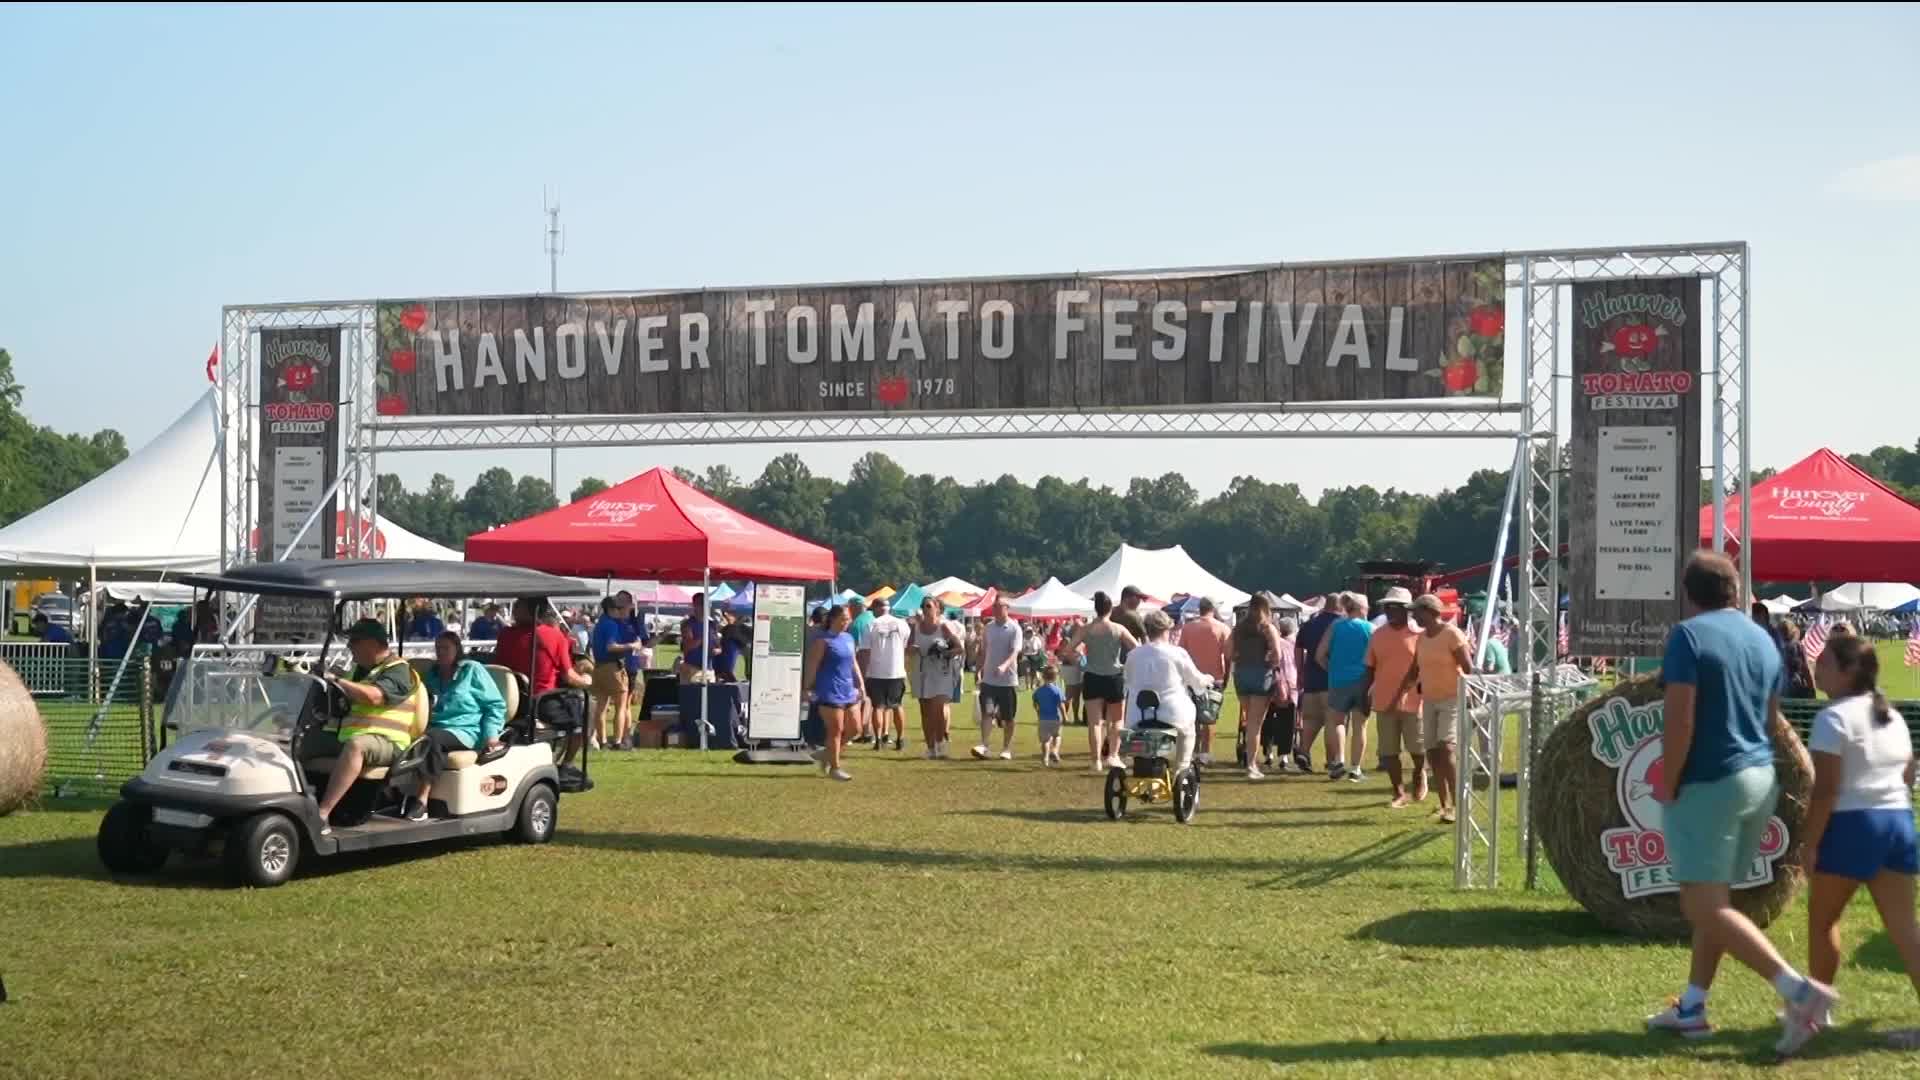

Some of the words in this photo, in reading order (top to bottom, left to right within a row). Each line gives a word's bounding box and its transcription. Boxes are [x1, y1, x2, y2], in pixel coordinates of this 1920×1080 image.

[1582, 290, 1686, 328] Hanover
[433, 312, 711, 392] HANOVER
[745, 299, 1015, 365] TOMATO
[1055, 290, 1419, 372] FESTIVAL
[819, 381, 865, 397] SINCE
[916, 378, 954, 395] 1978
[1583, 371, 1691, 394] TOMATO
[1594, 395, 1677, 408] FESTIVAL
[265, 402, 334, 421] TOMATO
[273, 422, 325, 432] FESTIVAL
[1771, 486, 1871, 502] Hanover
[1780, 497, 1856, 513] County
